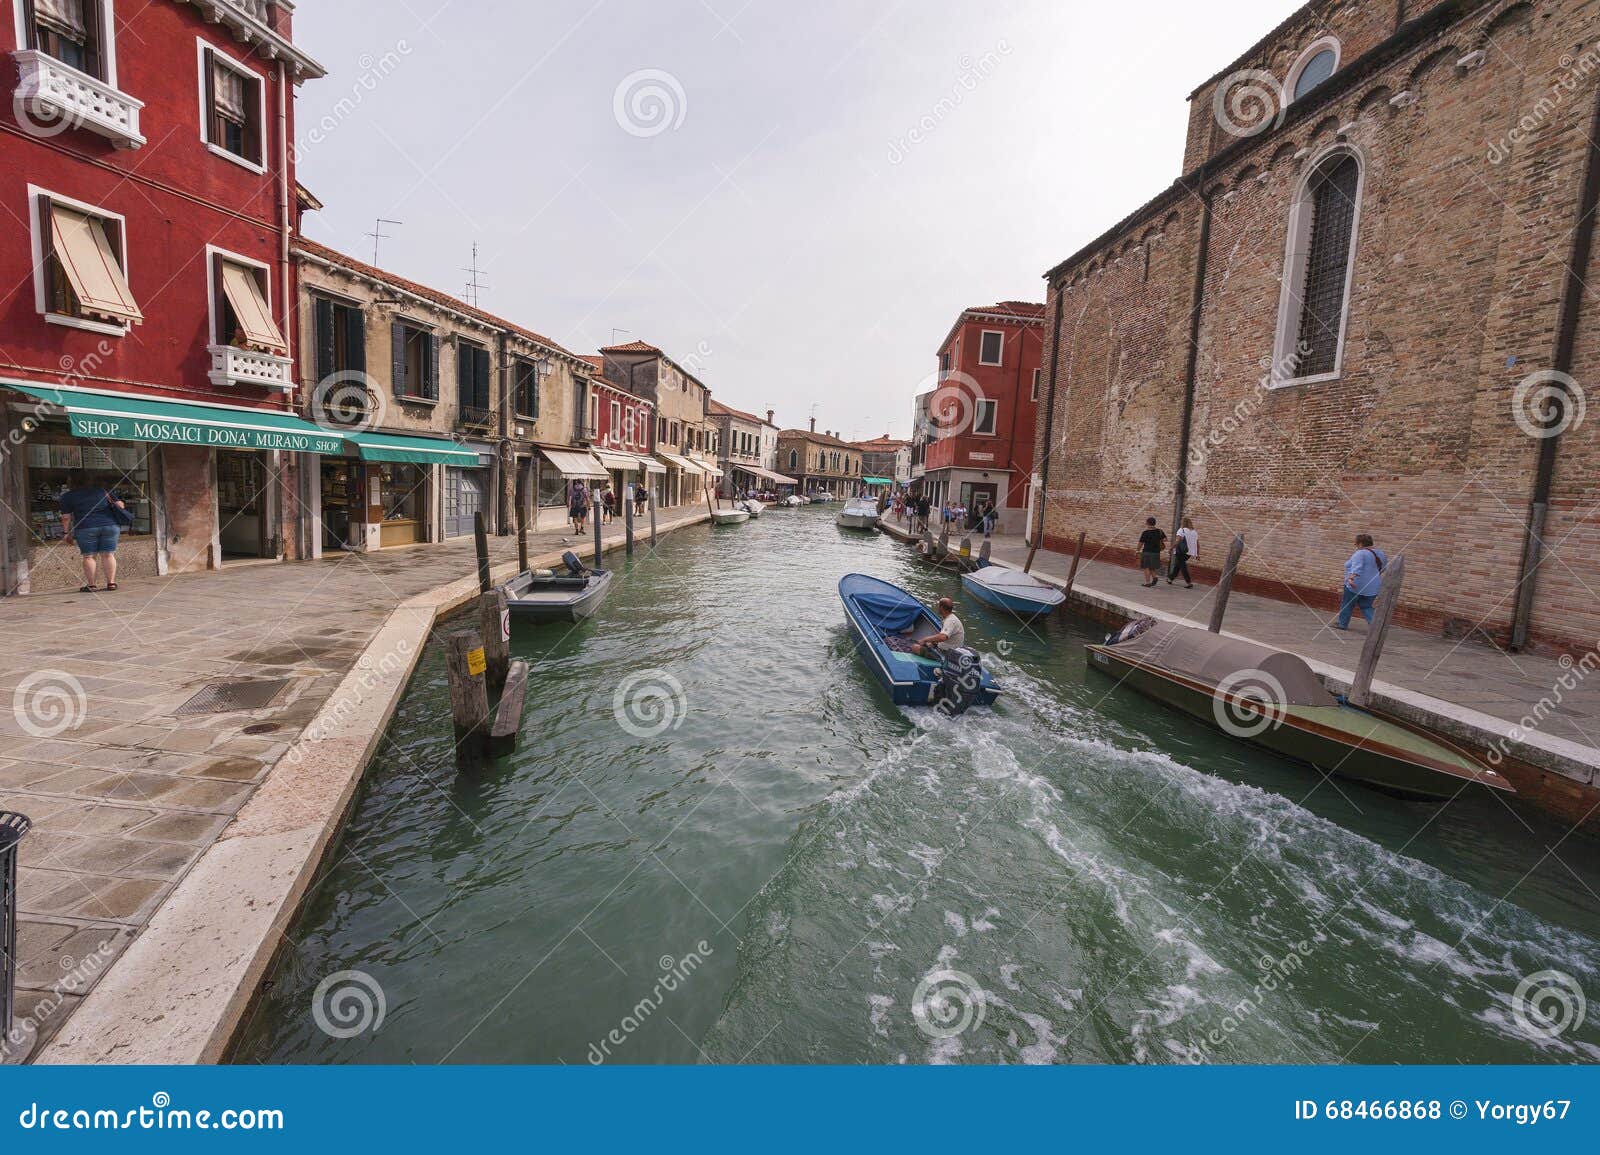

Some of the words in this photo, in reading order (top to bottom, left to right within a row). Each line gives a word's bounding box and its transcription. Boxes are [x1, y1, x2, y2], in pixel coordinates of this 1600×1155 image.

[78, 420, 119, 436] SHOP
[134, 422, 201, 442] MOSAICI
[256, 432, 309, 449] MURANO
[315, 440, 338, 452] SHOP
